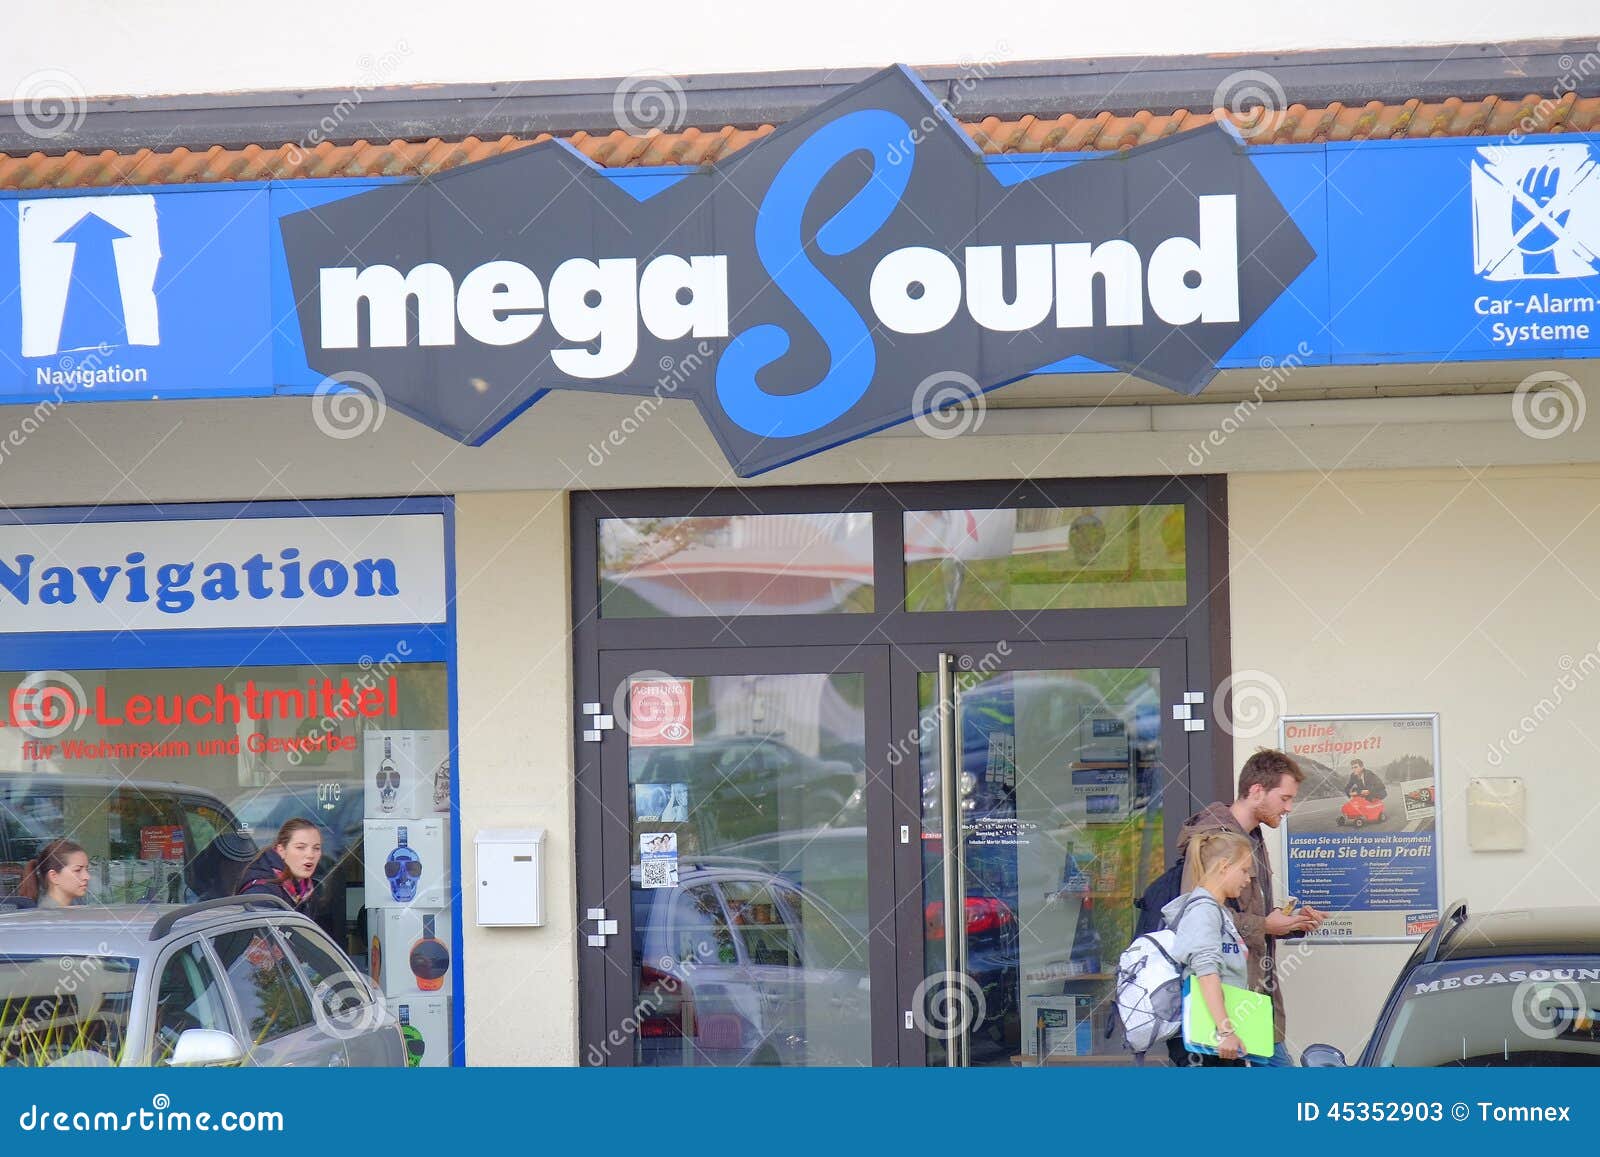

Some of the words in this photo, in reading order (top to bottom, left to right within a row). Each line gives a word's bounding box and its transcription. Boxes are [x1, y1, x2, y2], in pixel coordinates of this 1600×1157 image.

[1492, 322, 1590, 346] Systeme
[36, 365, 148, 388] Navigation
[0, 547, 399, 614] Navigation
[0, 675, 398, 729] ED-Leuchtmittel
[1286, 724, 1334, 739] Online
[23, 740, 56, 760] für
[61, 739, 190, 760] Wohnraum
[197, 735, 240, 755] und
[247, 731, 356, 754] Gewerbe
[1293, 736, 1382, 754] vershoppt?!
[1290, 837, 1317, 845] Lassen
[1318, 836, 1331, 844] Sie
[1342, 836, 1362, 844] nicht
[1392, 835, 1431, 843] kommen!
[1290, 847, 1335, 859] Kaufen
[1338, 847, 1357, 858] Sie
[1360, 846, 1392, 857] beim
[1395, 845, 1432, 857] Profi!
